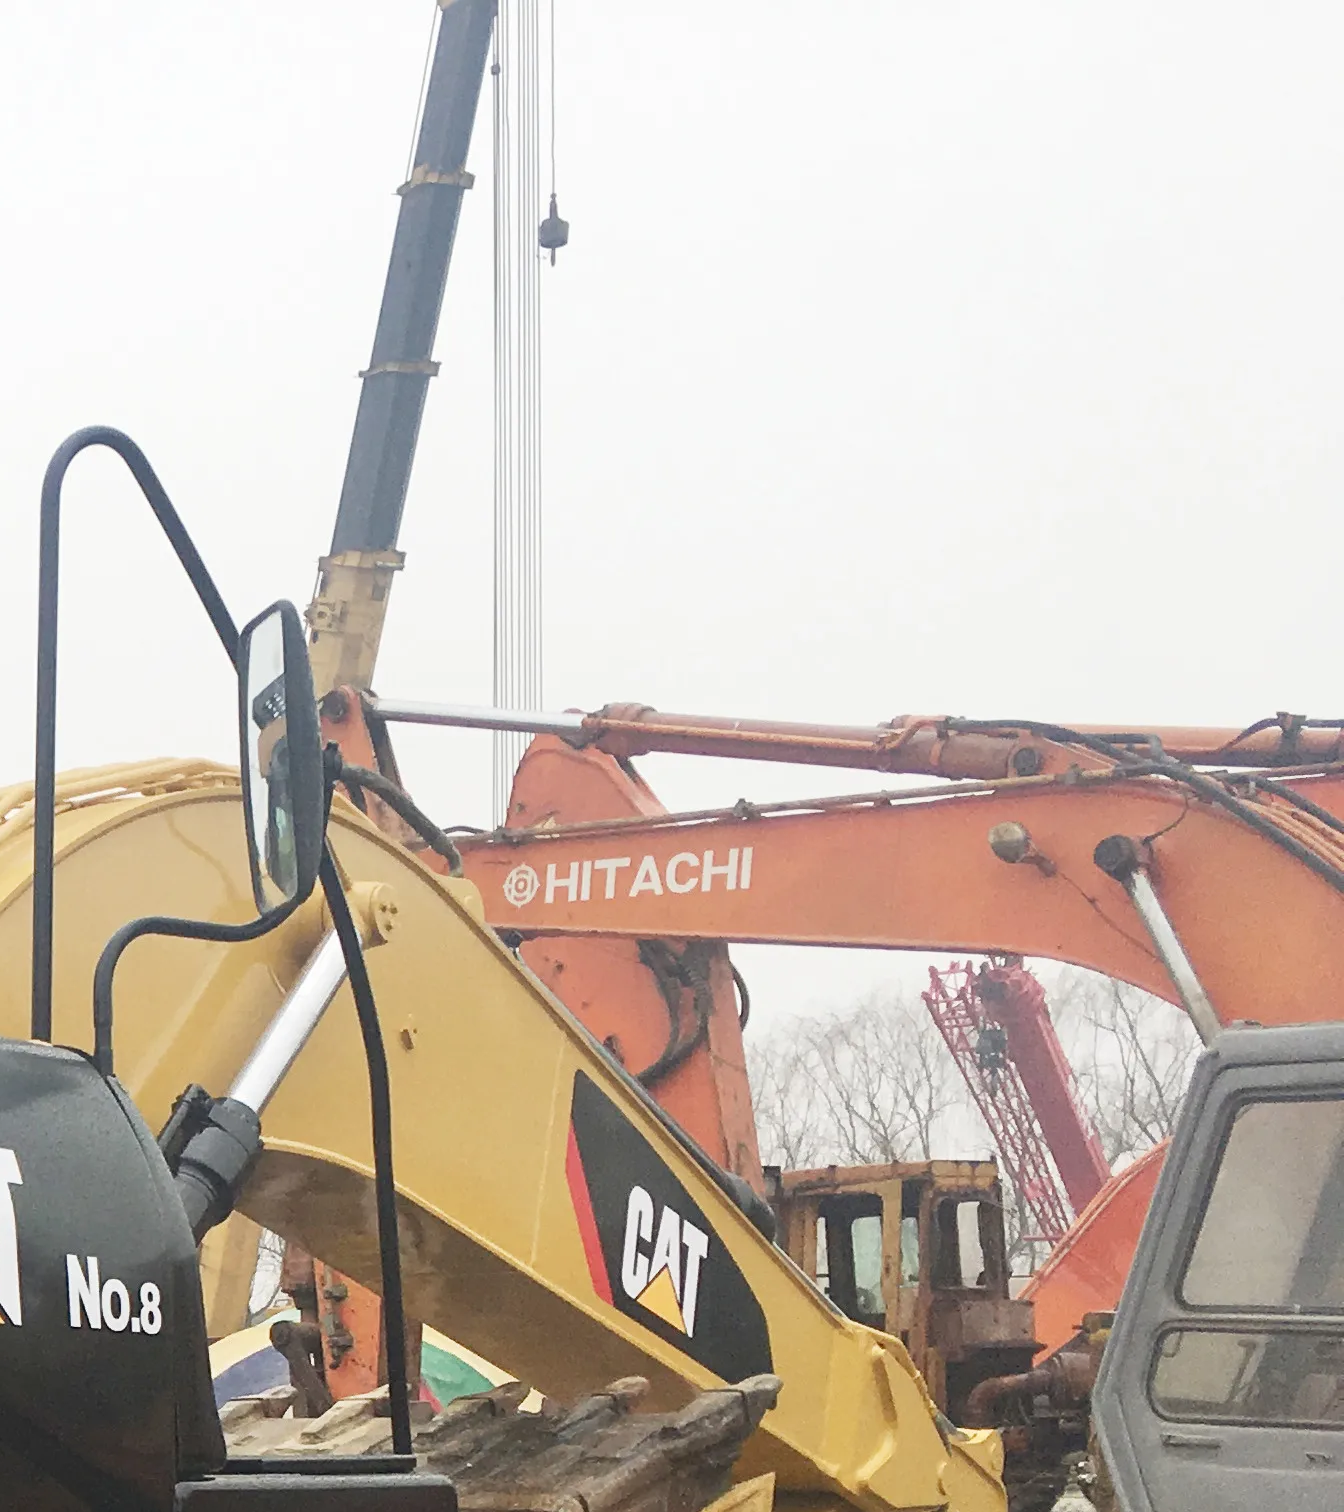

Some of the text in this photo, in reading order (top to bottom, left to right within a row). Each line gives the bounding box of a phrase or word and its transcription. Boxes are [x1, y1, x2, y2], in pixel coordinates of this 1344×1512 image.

[544, 846, 754, 904] HITACHI
[66, 1253, 162, 1335] No.8
[621, 1185, 709, 1338] CAT
